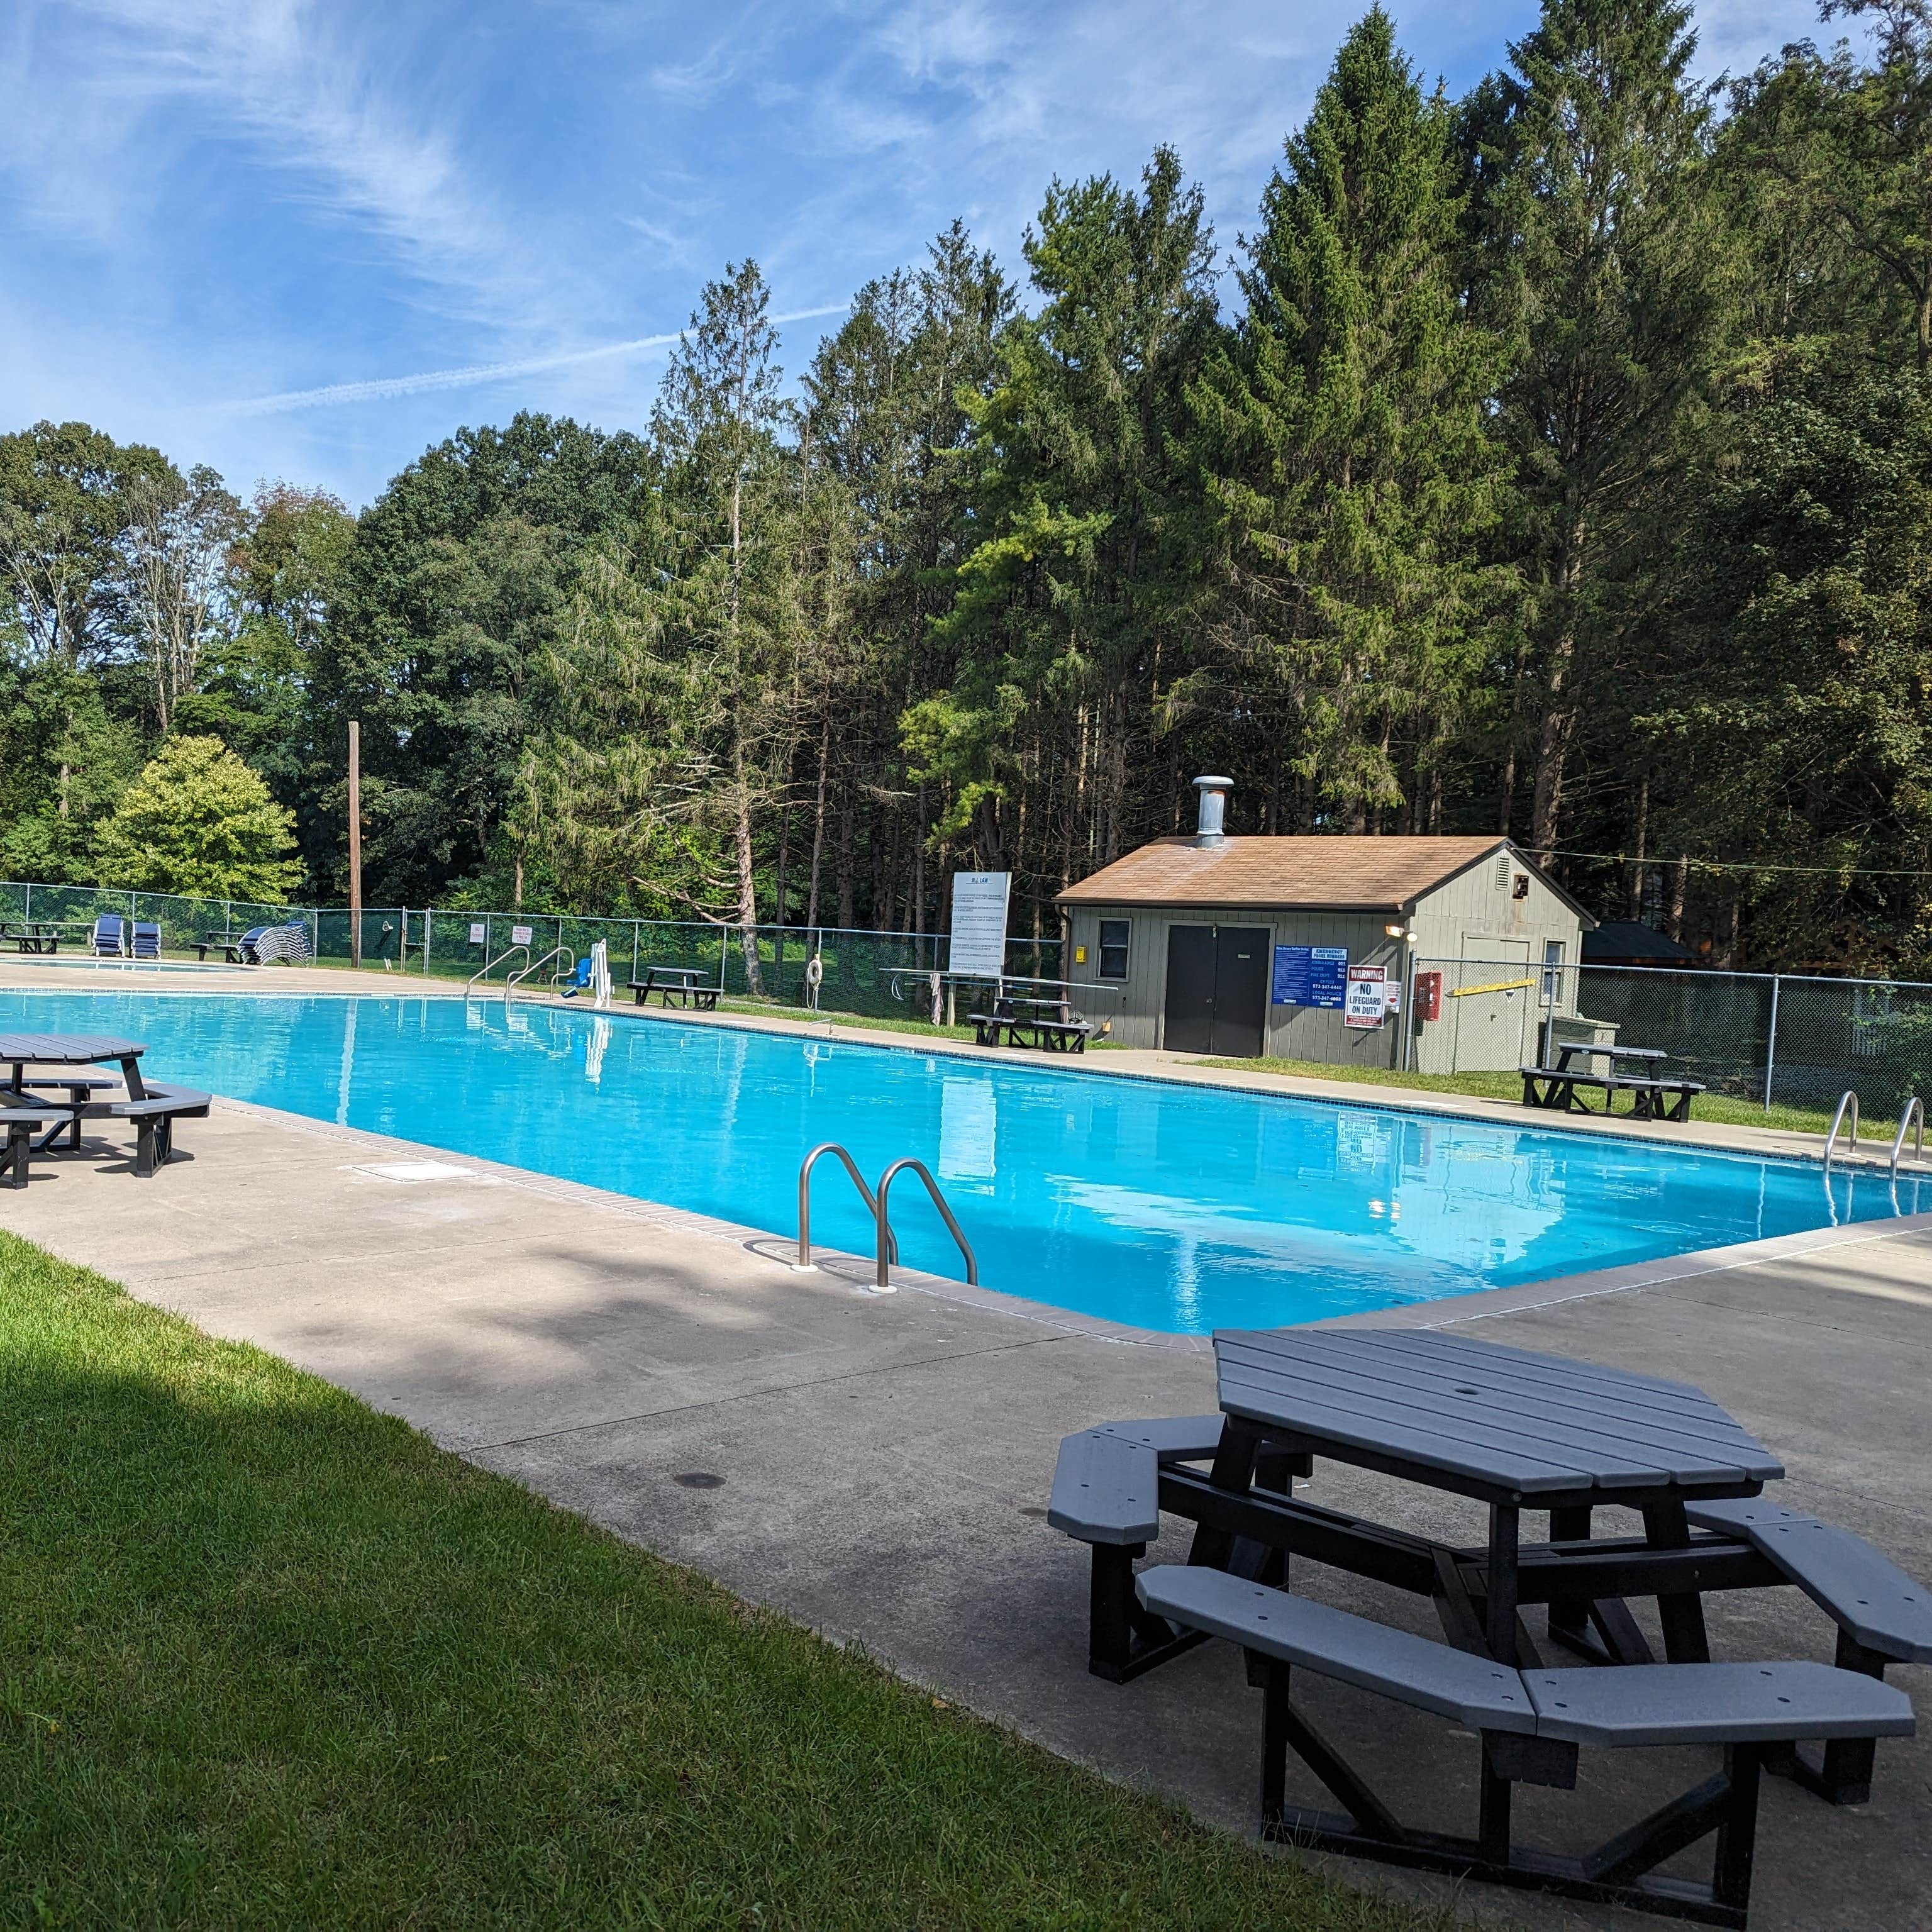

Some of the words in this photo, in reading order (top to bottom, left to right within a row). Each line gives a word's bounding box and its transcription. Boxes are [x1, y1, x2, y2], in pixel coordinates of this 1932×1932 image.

[1350, 969, 1384, 980] WARNING
[1360, 983, 1372, 996] NO
[1349, 996, 1381, 1006] LIFEGUARD
[1362, 1007, 1378, 1015] DUTY
